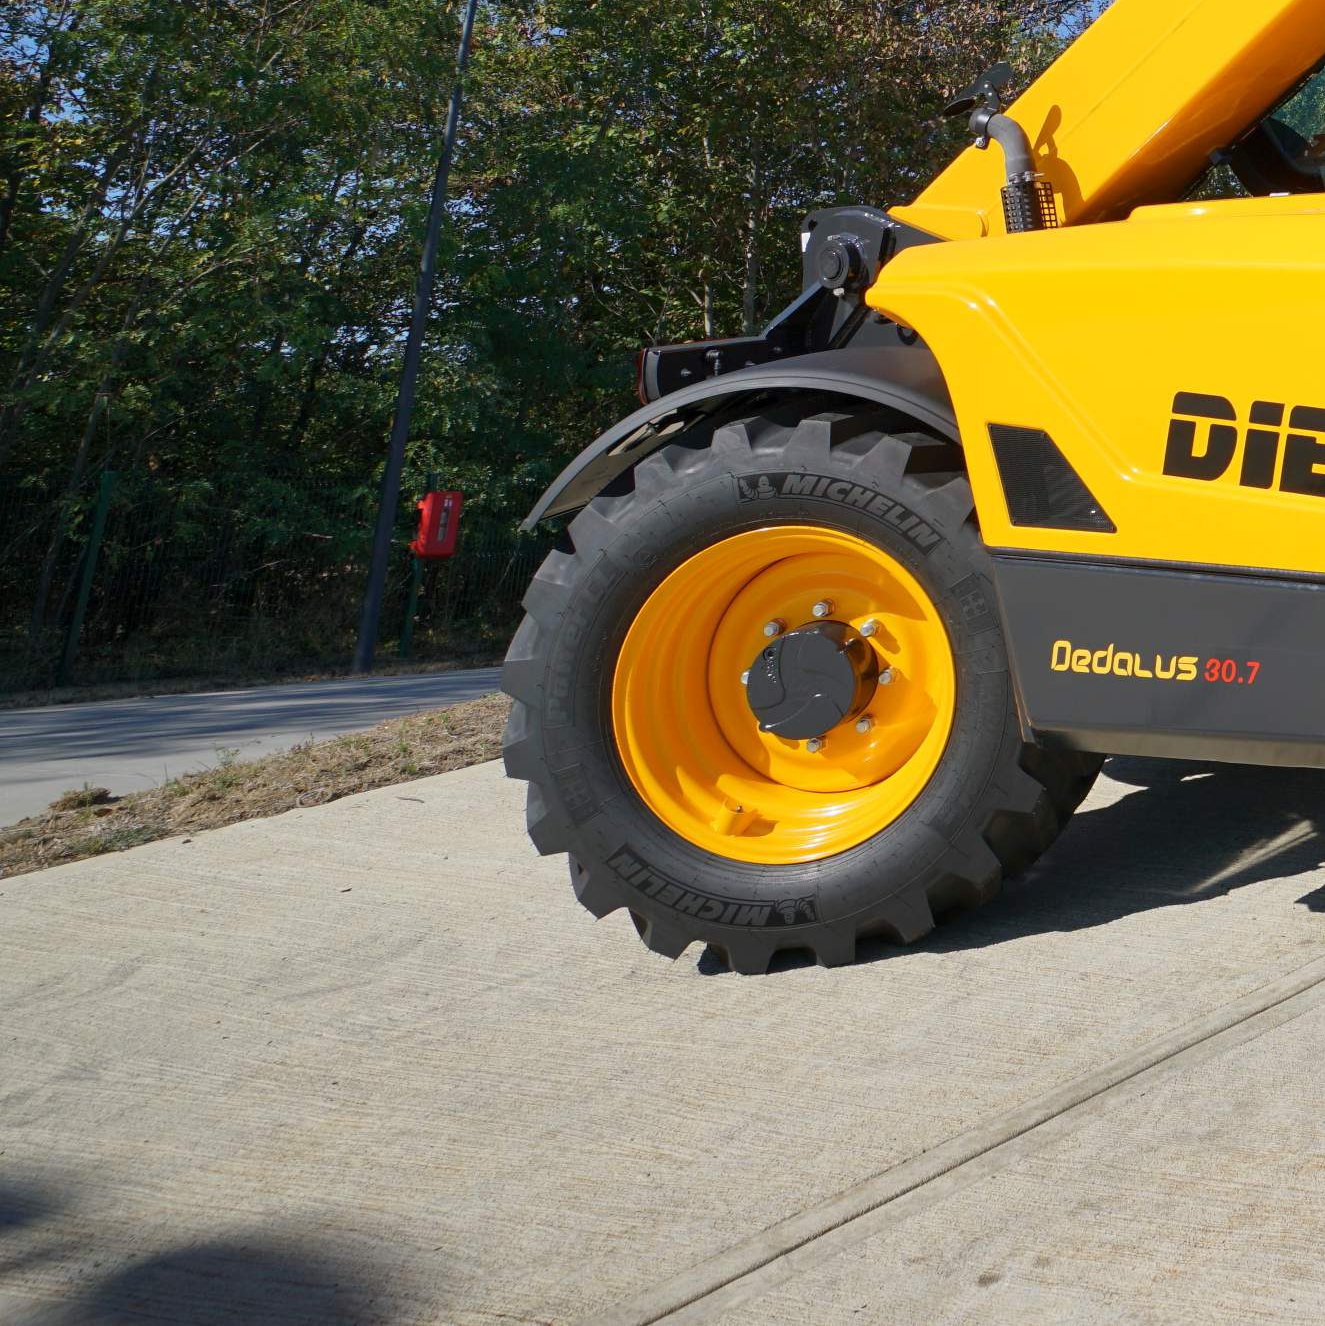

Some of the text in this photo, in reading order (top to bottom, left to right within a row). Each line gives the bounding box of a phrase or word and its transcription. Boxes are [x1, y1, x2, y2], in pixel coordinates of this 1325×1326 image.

[781, 474, 943, 548] MICHELIN
[1205, 658, 1261, 684] 30.7
[606, 854, 775, 926] MICHELIN
